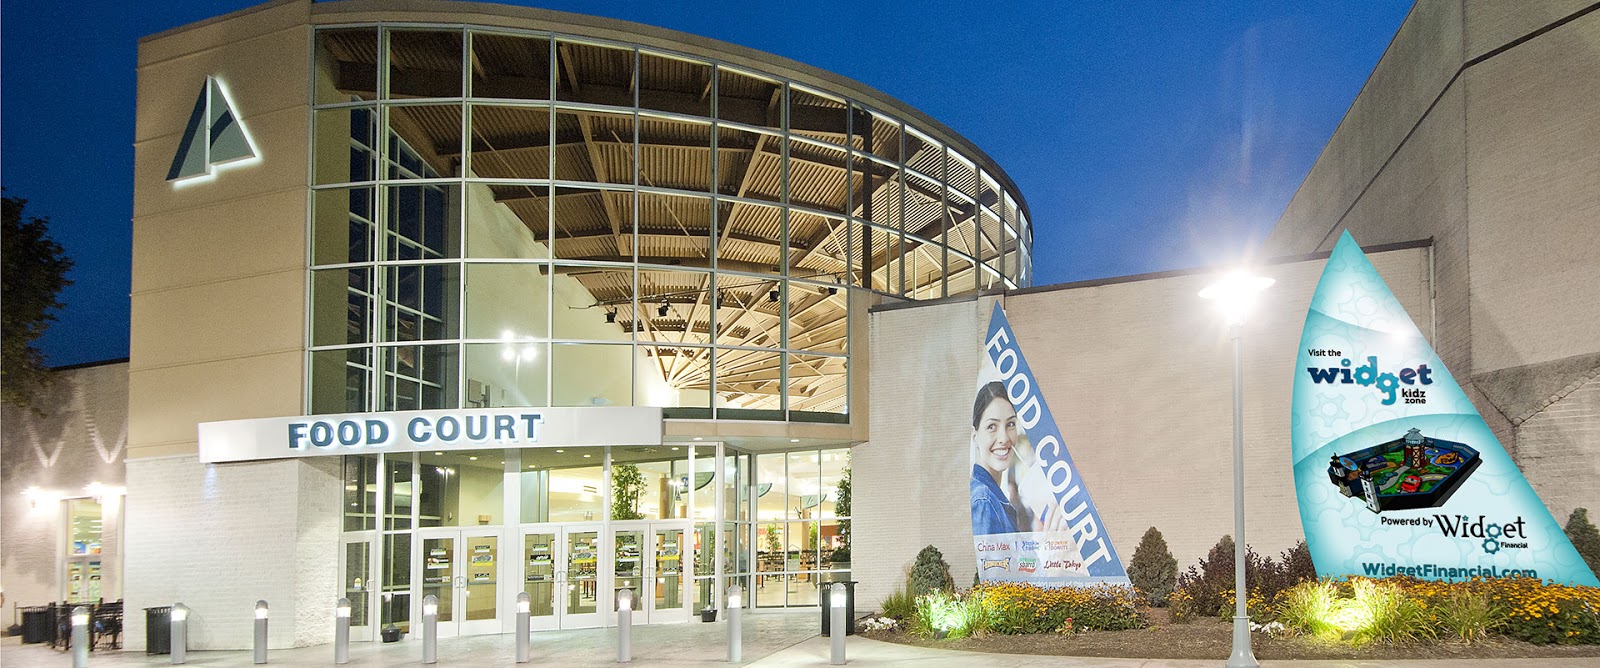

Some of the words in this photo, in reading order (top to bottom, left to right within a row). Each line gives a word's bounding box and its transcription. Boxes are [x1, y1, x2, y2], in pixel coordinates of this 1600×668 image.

[1308, 349, 1326, 357] Visit
[1328, 349, 1341, 357] the
[1307, 356, 1433, 406] widget
[1402, 388, 1426, 398] kidz
[288, 419, 390, 449] FOOD
[407, 414, 544, 443] COURT
[985, 327, 1042, 430] FOOD
[1035, 435, 1112, 577] COURT
[1381, 516, 1421, 526] Powered
[1422, 518, 1434, 528] by
[977, 540, 996, 551] China
[996, 542, 1011, 551] Max
[1043, 560, 1062, 569] Little
